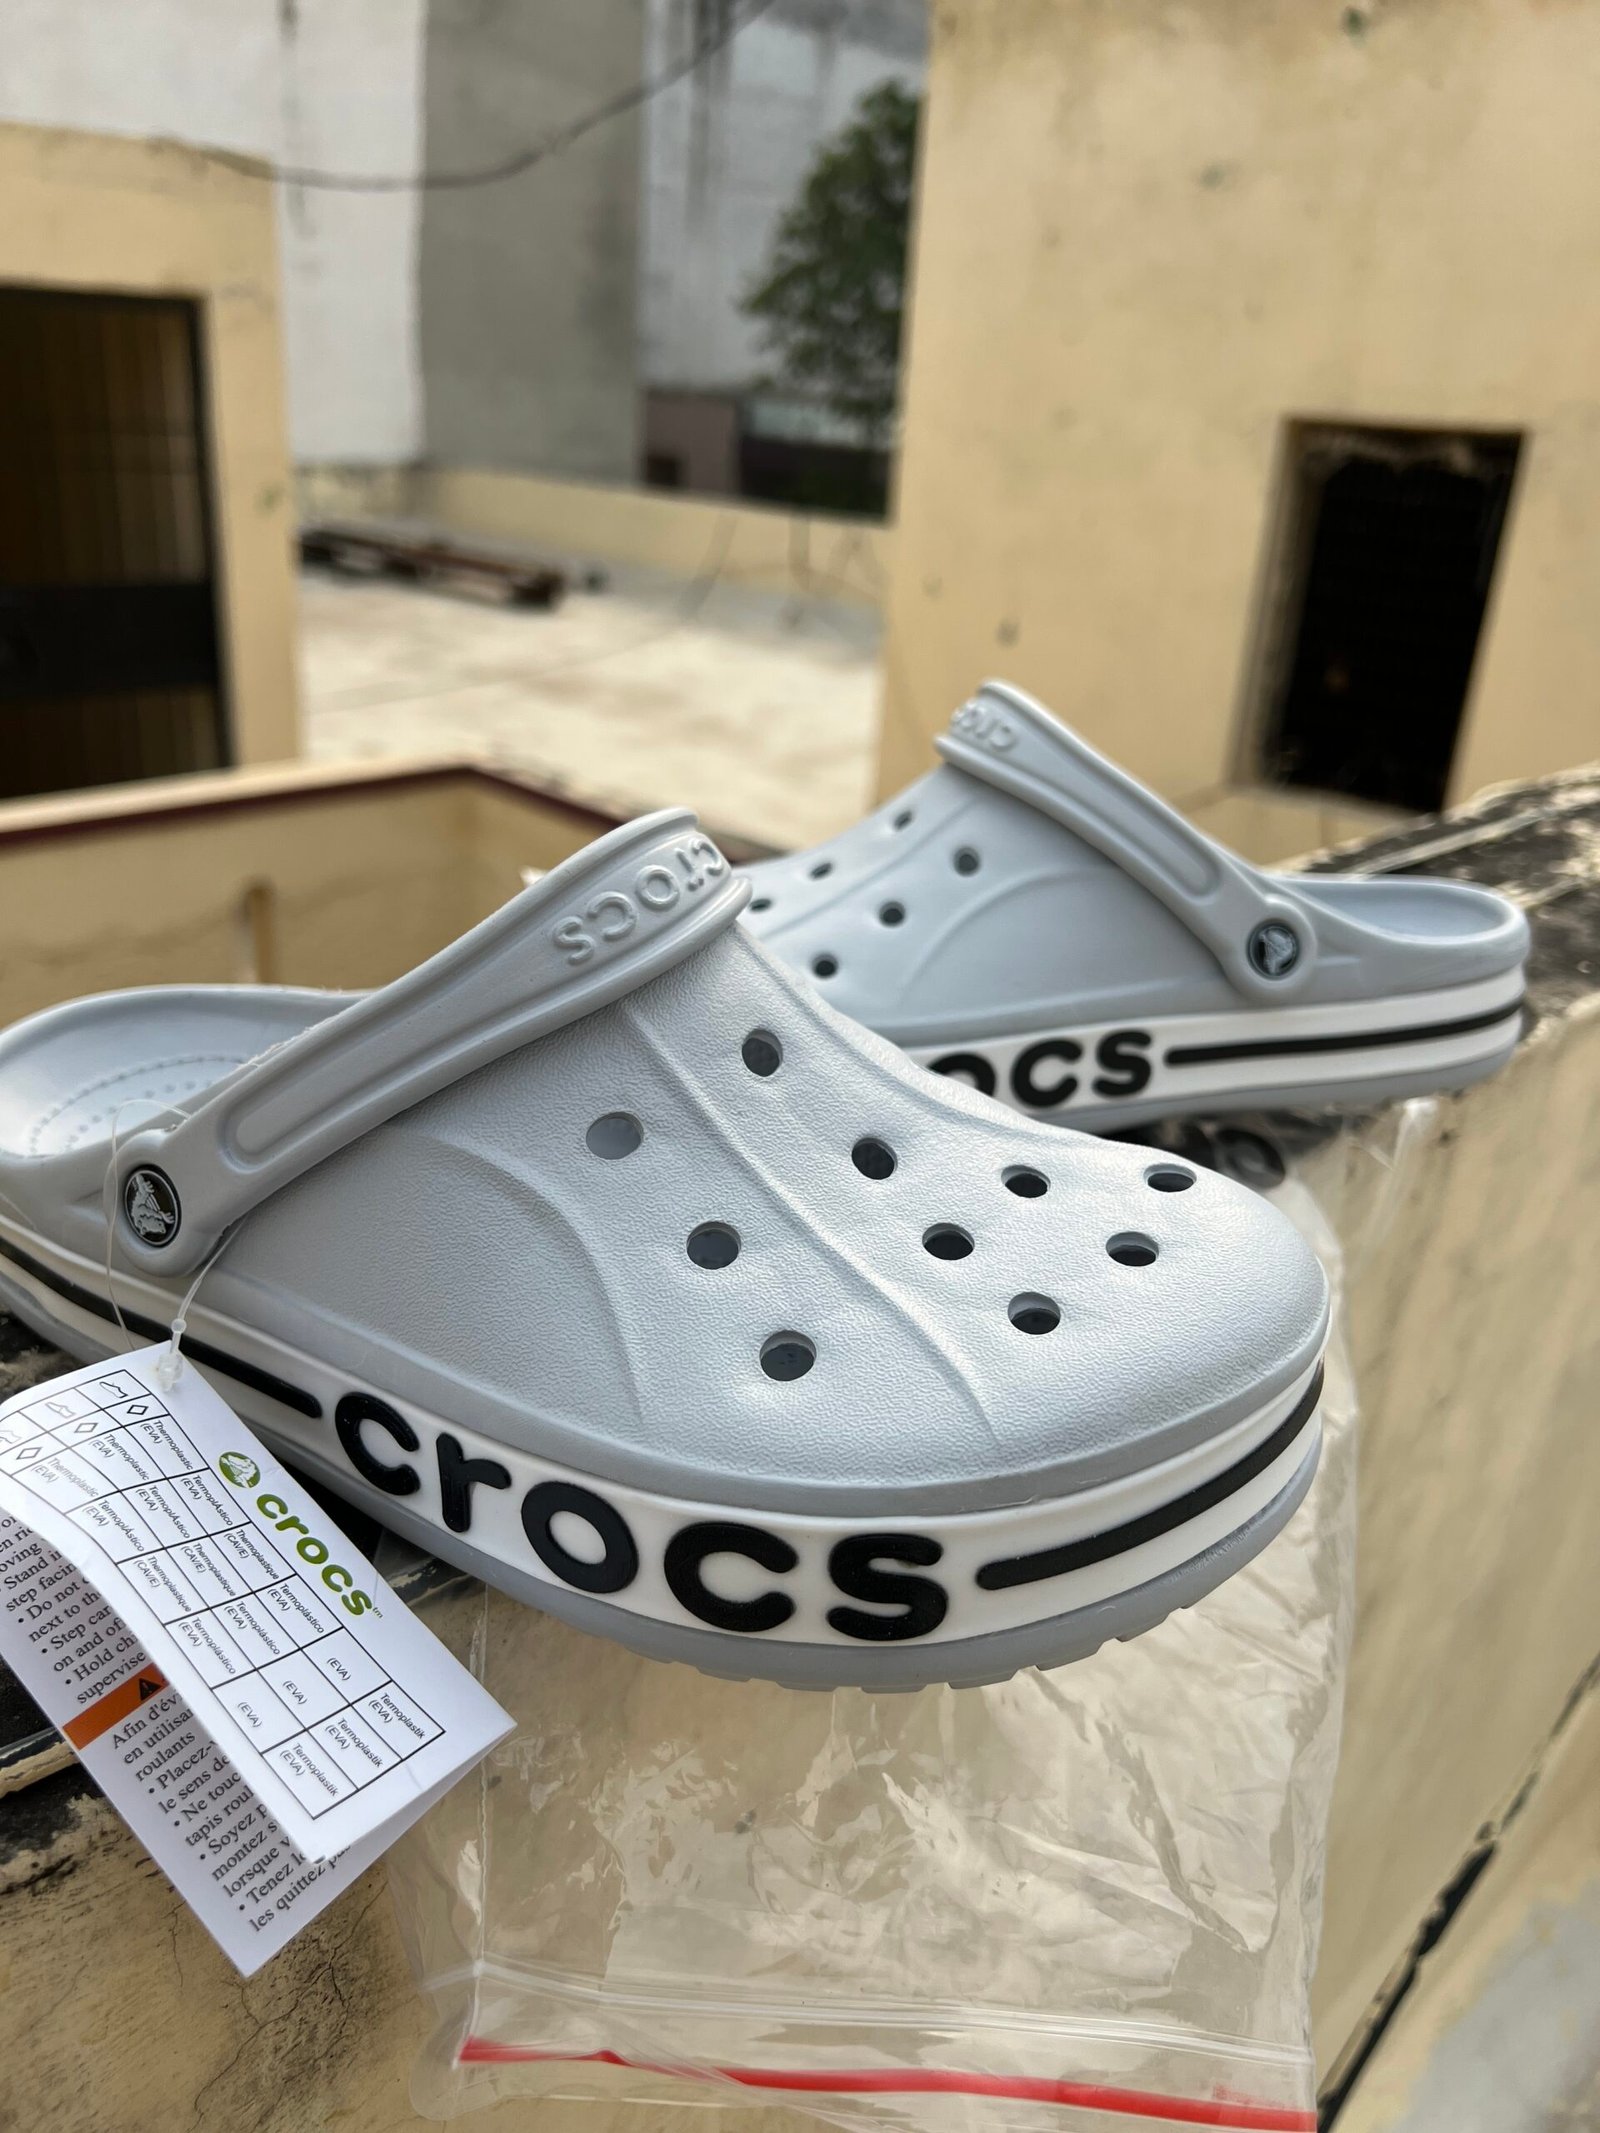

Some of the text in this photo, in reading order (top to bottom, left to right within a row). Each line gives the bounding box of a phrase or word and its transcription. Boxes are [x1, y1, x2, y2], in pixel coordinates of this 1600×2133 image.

[552, 838, 724, 966] crocs
[88, 1439, 114, 1458] (EVA)
[140, 1422, 162, 1444] (EVA)
[153, 1419, 194, 1470] Thermoplastic
[31, 1464, 60, 1483] (EVA)
[103, 1434, 149, 1481] Thermoplastic
[47, 1457, 100, 1498] Thermoplastic
[181, 1477, 203, 1500] (EVA)
[82, 1505, 110, 1527] (EVA)
[135, 1488, 158, 1511] (EVA)
[334, 1391, 949, 1641] crocs
[193, 1542, 236, 1597] Thermoplastique
[236, 1529, 280, 1580] Thermoplastique
[256, 1493, 373, 1616] crocs
[4, 1556, 49, 1590] Stand
[147, 1555, 192, 1612] Thermoplastique
[6, 1588, 37, 1612] step
[26, 1581, 80, 1619] Do not
[224, 1605, 247, 1629] (EVA)
[267, 1588, 291, 1611] (EVA)
[28, 1614, 63, 1643] next
[64, 1604, 81, 1619] to
[50, 1623, 86, 1650] Step
[179, 1621, 203, 1647] (EVA)
[53, 1654, 74, 1673] on
[75, 1632, 104, 1658] and
[74, 1649, 115, 1682] Hold
[327, 1657, 352, 1681] (EVA)
[77, 1651, 146, 1704] supervise
[283, 1680, 307, 1704] (EVA)
[237, 1701, 263, 1727] (EVA)
[368, 1699, 393, 1723] (EVA)
[379, 1692, 426, 1739] Termoplastik
[112, 1720, 147, 1749] Afin
[325, 1724, 351, 1750] (EVA)
[337, 1718, 384, 1768] Termoplastik
[124, 1747, 144, 1764] en
[135, 1731, 196, 1782] roulants
[279, 1749, 306, 1776] (EVA)
[292, 1743, 339, 1797] Termoplastik
[158, 1798, 177, 1814] le
[178, 1770, 211, 1800] sens
[181, 1799, 208, 1822] Ne
[185, 1816, 223, 1847] tapis
[208, 1813, 257, 1855] Soyez
[212, 1830, 268, 1881] montez
[223, 1847, 280, 1898] lorsque
[246, 1863, 294, 1904] Tenez
[249, 1863, 326, 1932] les quittez
